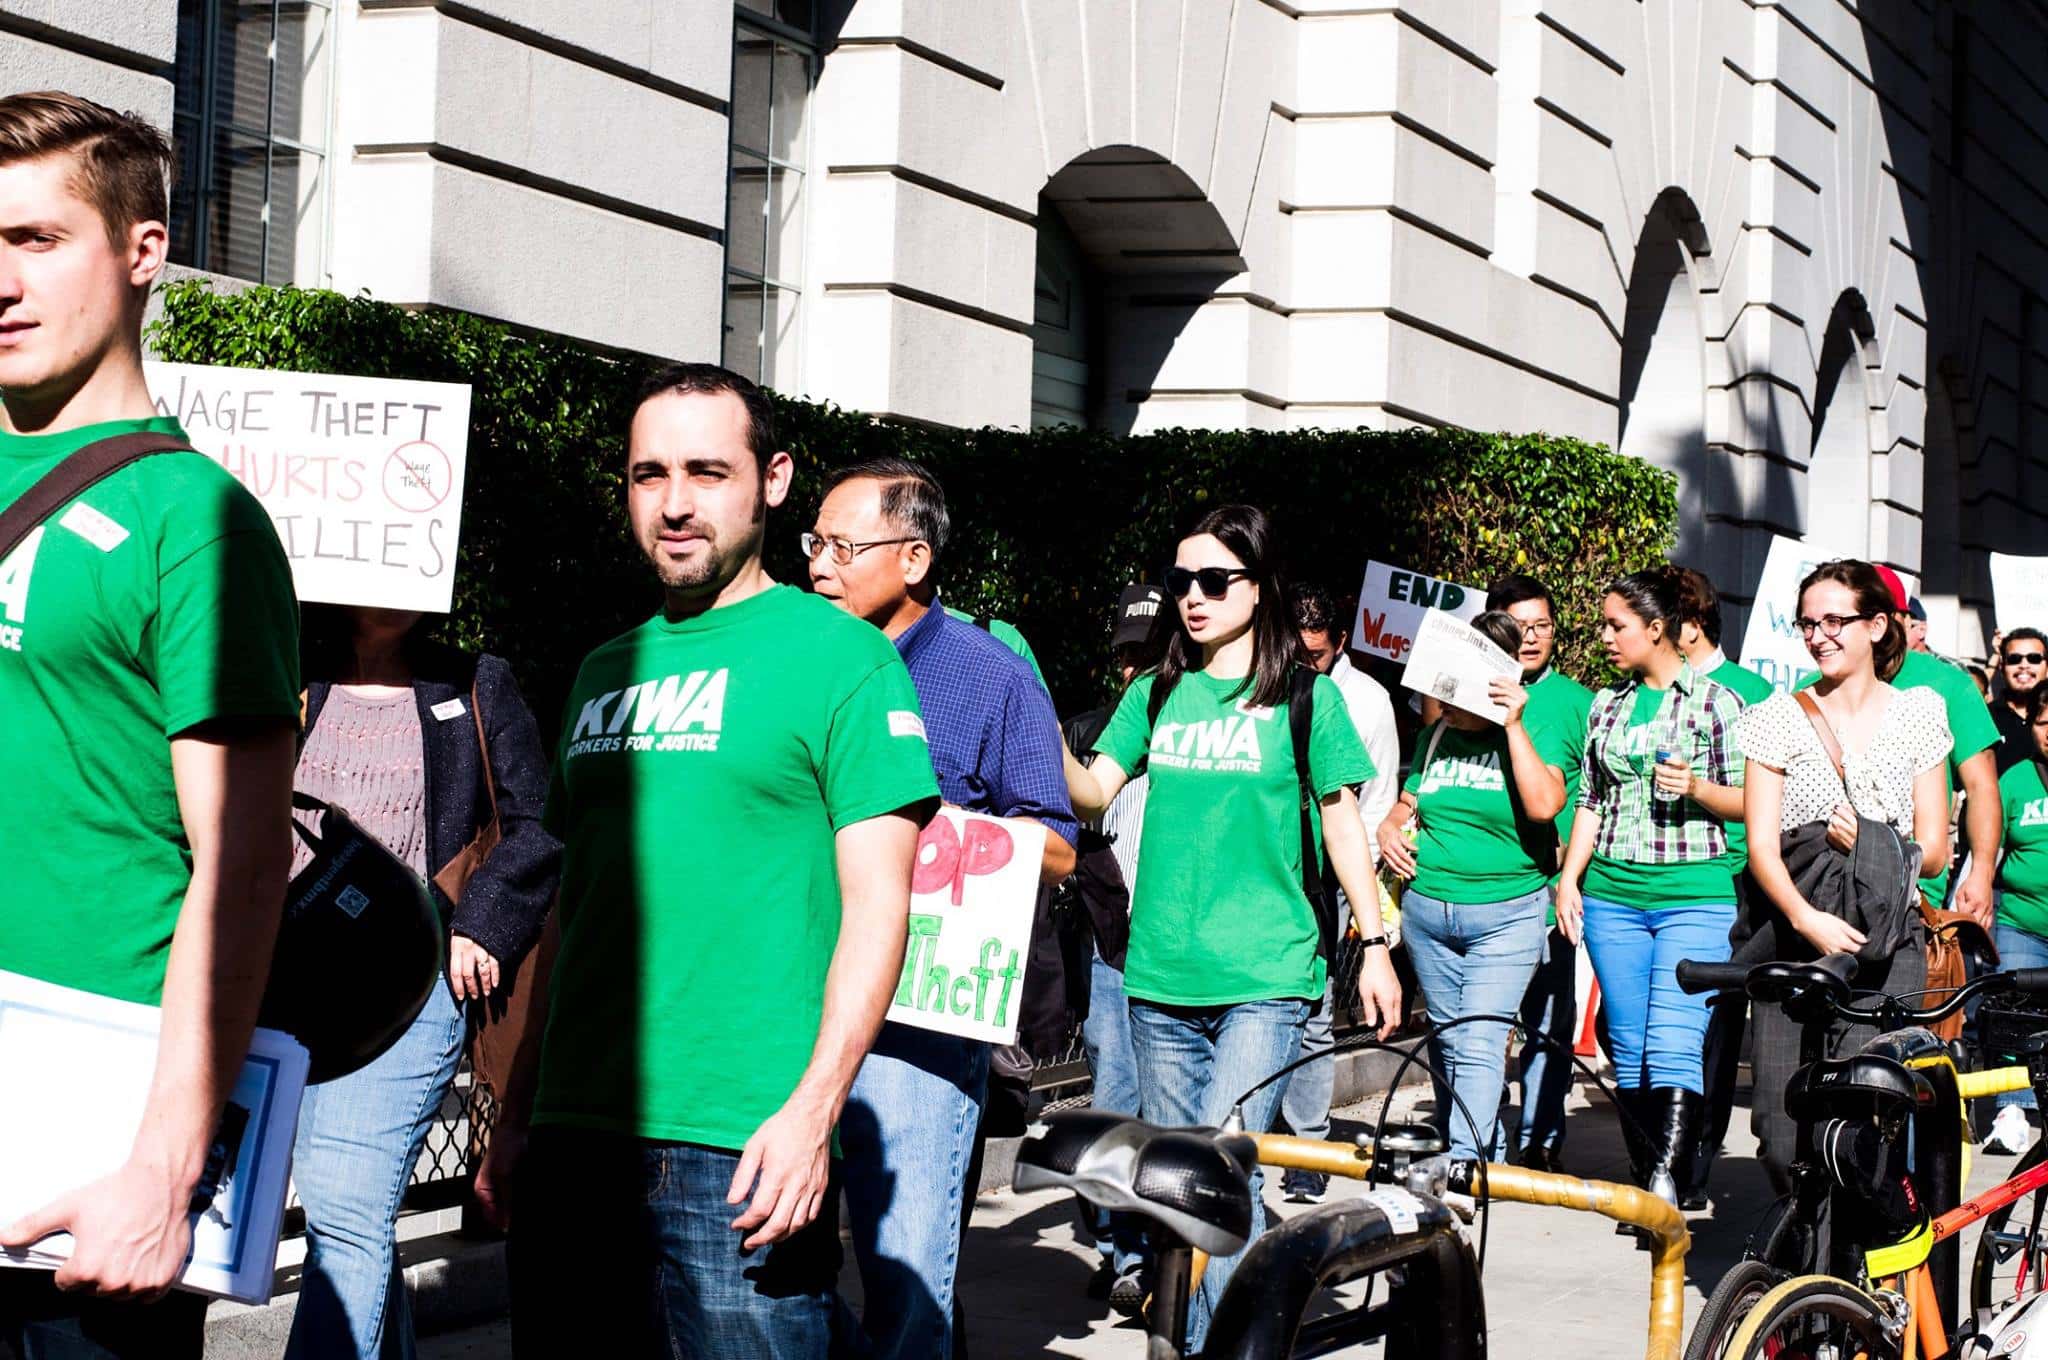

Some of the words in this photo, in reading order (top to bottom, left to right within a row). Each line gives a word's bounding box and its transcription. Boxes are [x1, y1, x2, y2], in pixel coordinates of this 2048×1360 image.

[301, 390, 442, 441] THEFT
[223, 444, 367, 502] HURTS
[276, 516, 445, 578] ILIES
[1388, 571, 1465, 611] END
[1362, 608, 1411, 659] Wage
[571, 667, 729, 743] KIWA
[624, 735, 655, 752] FOR
[655, 733, 721, 752] JUSTICE
[1150, 716, 1262, 760] KIWA
[1429, 751, 1505, 783] KIWA
[911, 814, 1014, 906] OP
[894, 913, 1022, 1028] Theft
